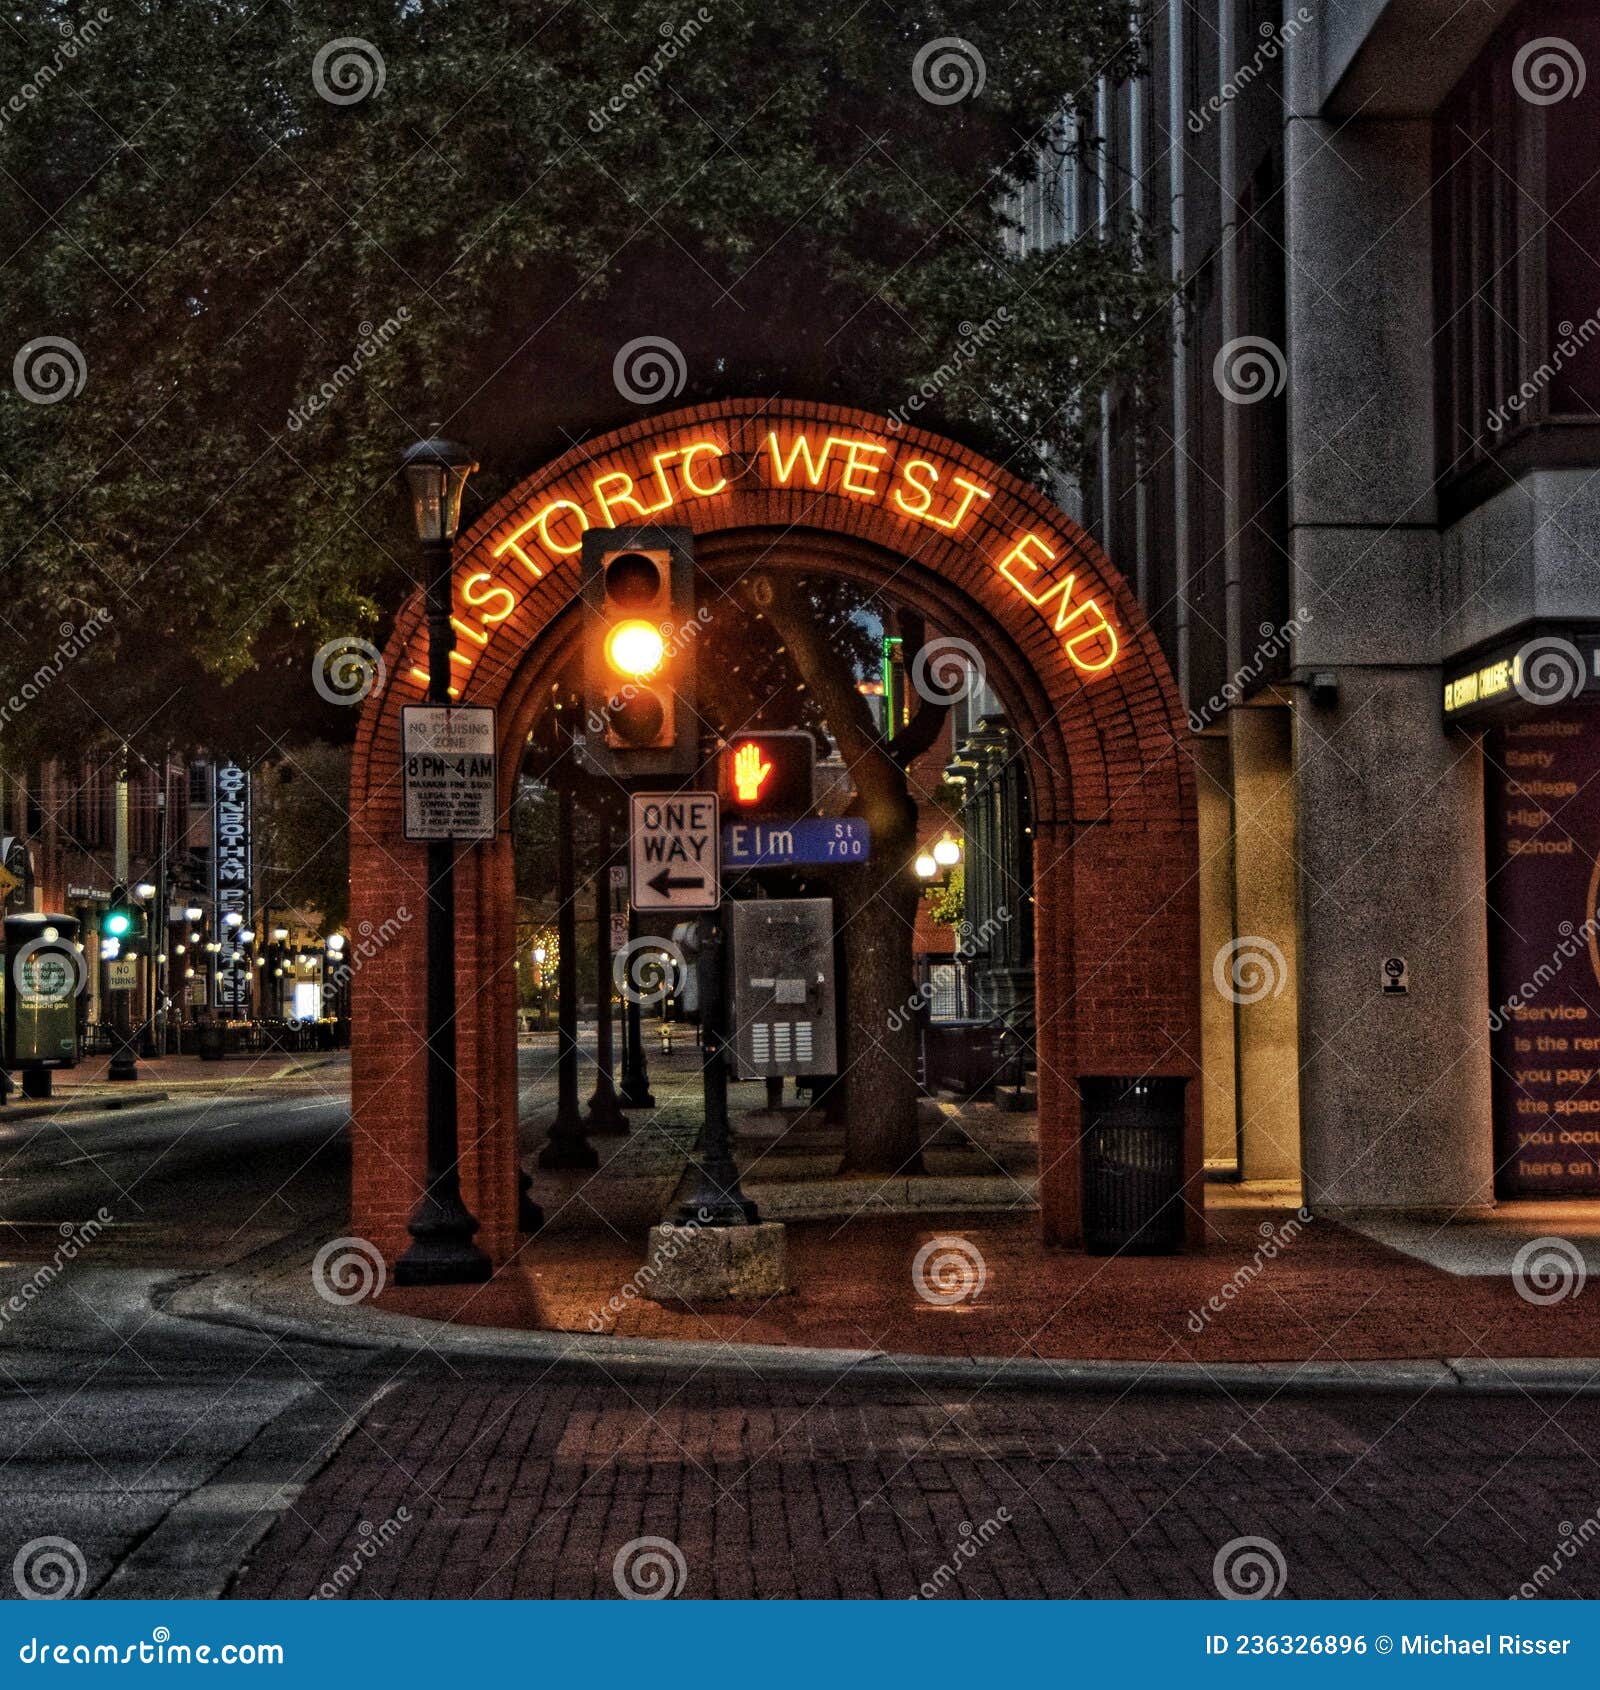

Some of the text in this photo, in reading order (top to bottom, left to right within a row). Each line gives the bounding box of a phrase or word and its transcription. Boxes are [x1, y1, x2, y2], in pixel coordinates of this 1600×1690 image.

[768, 431, 992, 529] WEST
[999, 533, 1119, 671] END
[409, 722, 489, 735] NO CRUISING
[434, 737, 467, 748] ZONE
[1506, 780, 1578, 797] College
[643, 804, 707, 829] ONE
[835, 823, 853, 838] St
[644, 835, 708, 862] WAY
[733, 825, 794, 857] Elm
[828, 840, 862, 856] 700
[1507, 838, 1574, 855] School
[117, 965, 130, 975] NO
[111, 977, 136, 985] TURNS
[1514, 1006, 1588, 1020] Service
[1515, 1036, 1531, 1051] is
[1536, 1035, 1569, 1051] the
[1516, 1068, 1593, 1085] you pay
[1517, 1099, 1549, 1113] the
[1518, 1131, 1553, 1146] you
[1519, 1160, 1593, 1176] here on
